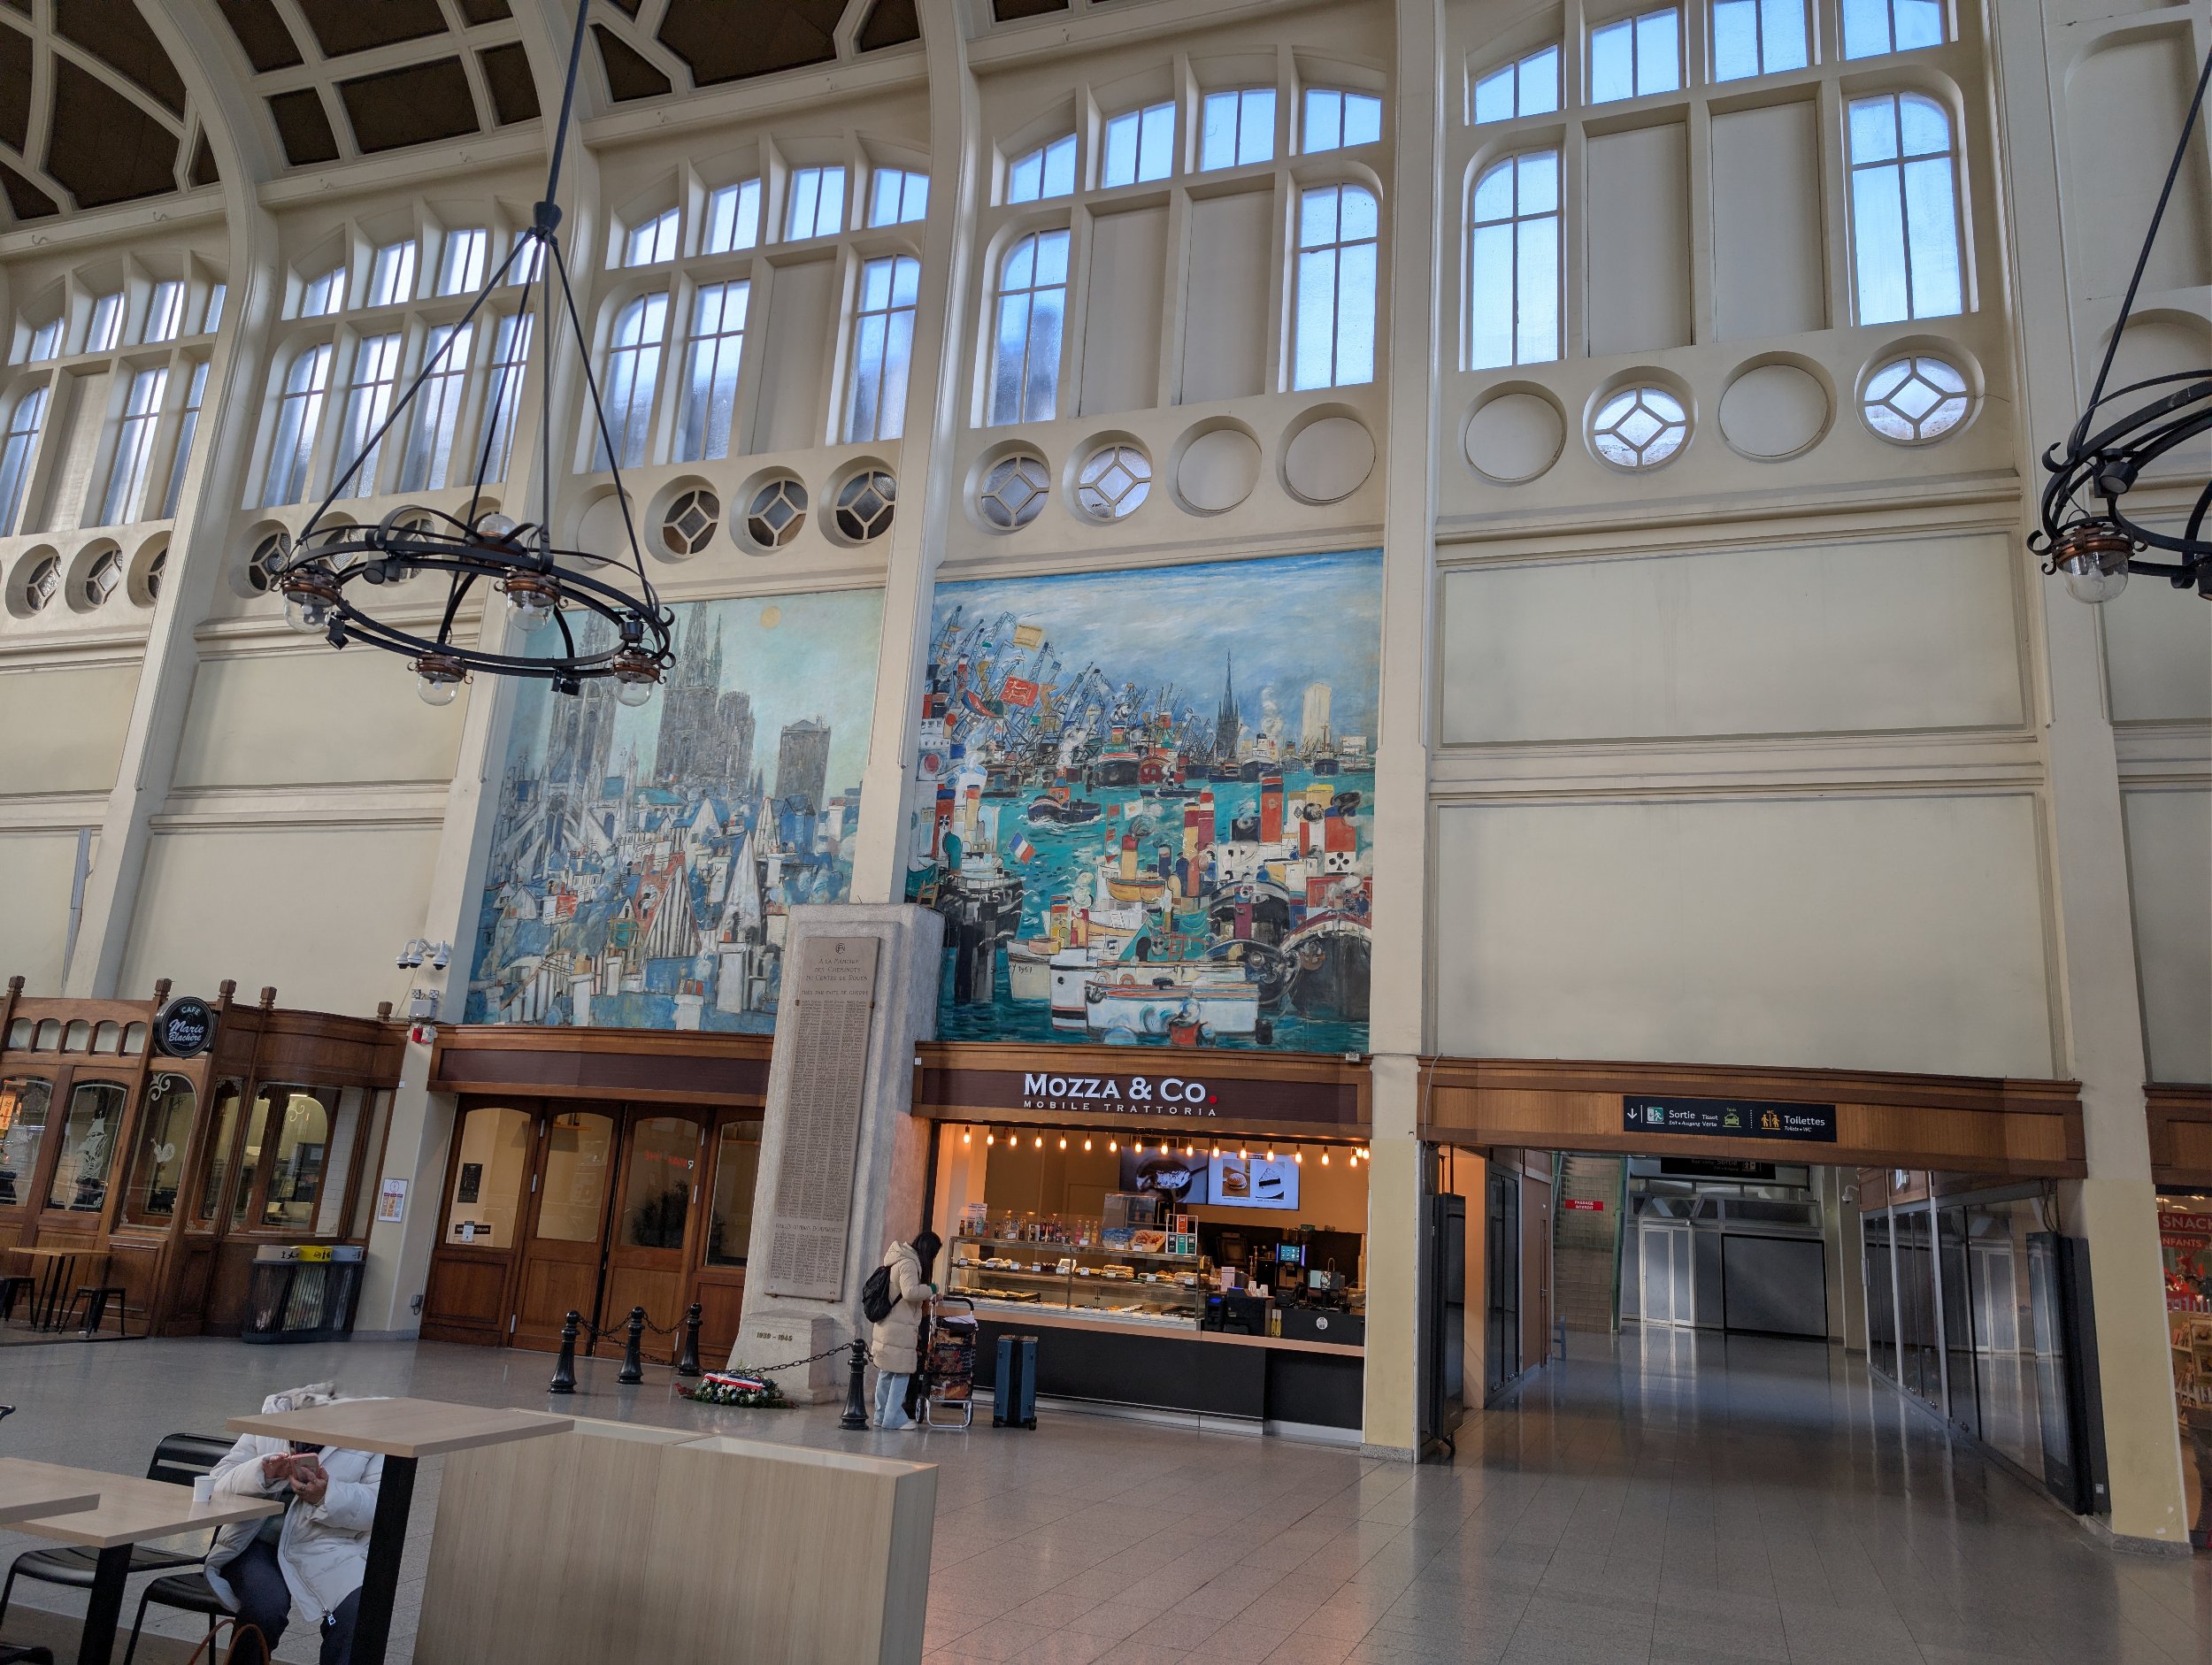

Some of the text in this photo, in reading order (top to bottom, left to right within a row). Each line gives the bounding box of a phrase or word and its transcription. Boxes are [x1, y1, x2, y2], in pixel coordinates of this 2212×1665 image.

[169, 1019, 204, 1033] Marie
[169, 1032, 202, 1041] Blachère
[1128, 1077, 1151, 1101] &
[1024, 1100, 1217, 1117] MOBILE TRATTORIA
[1669, 1109, 1695, 1119] Sortie
[1784, 1115, 1825, 1126] Toilettes
